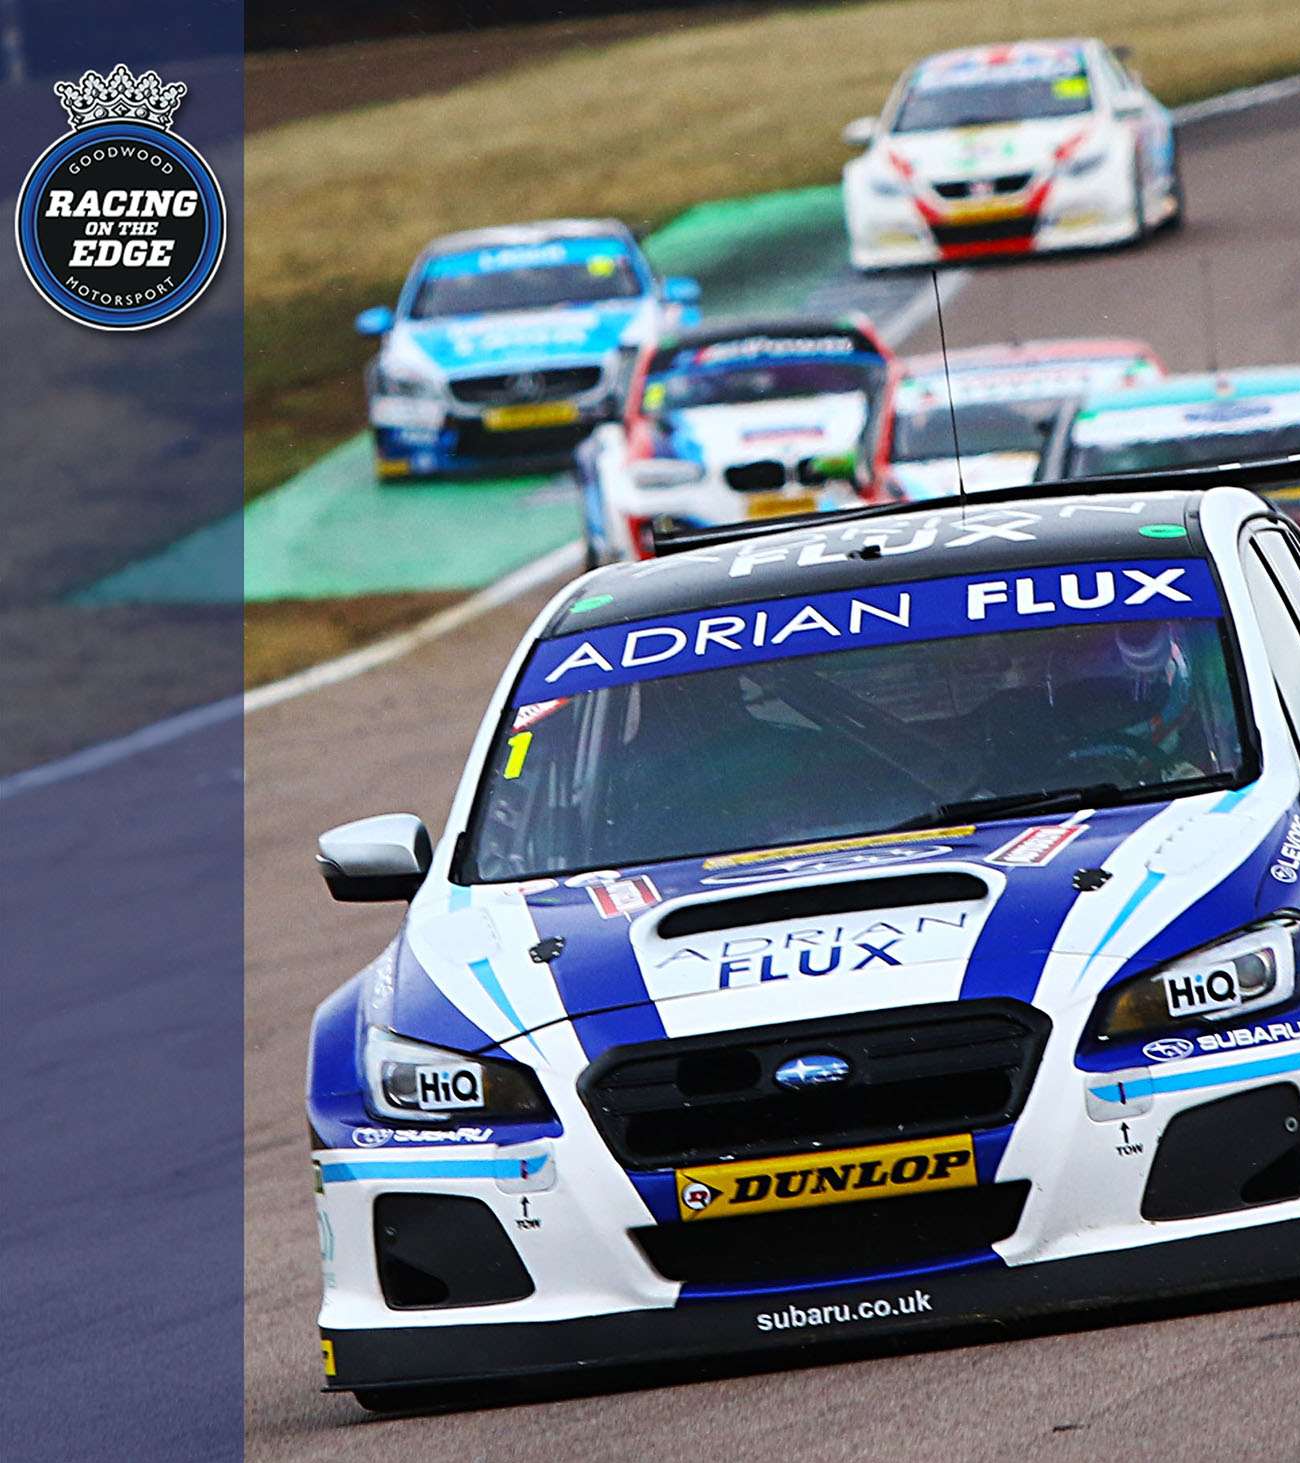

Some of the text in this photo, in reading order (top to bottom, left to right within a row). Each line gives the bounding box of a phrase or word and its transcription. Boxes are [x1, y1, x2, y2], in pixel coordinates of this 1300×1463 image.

[545, 567, 1193, 684] ADRIAN FLUX
[503, 731, 533, 780] 1
[655, 911, 968, 969] ADRIAN
[718, 938, 904, 990] FLUX
[1168, 969, 1237, 1009] HiQ
[419, 1070, 480, 1104] HiQ
[393, 1127, 494, 1142] SUBARU
[1115, 1142, 1143, 1157] TOW
[729, 1149, 972, 1205] DUNLOP
[515, 1219, 541, 1230] TOW
[756, 1289, 933, 1332] subaru.co.uk
